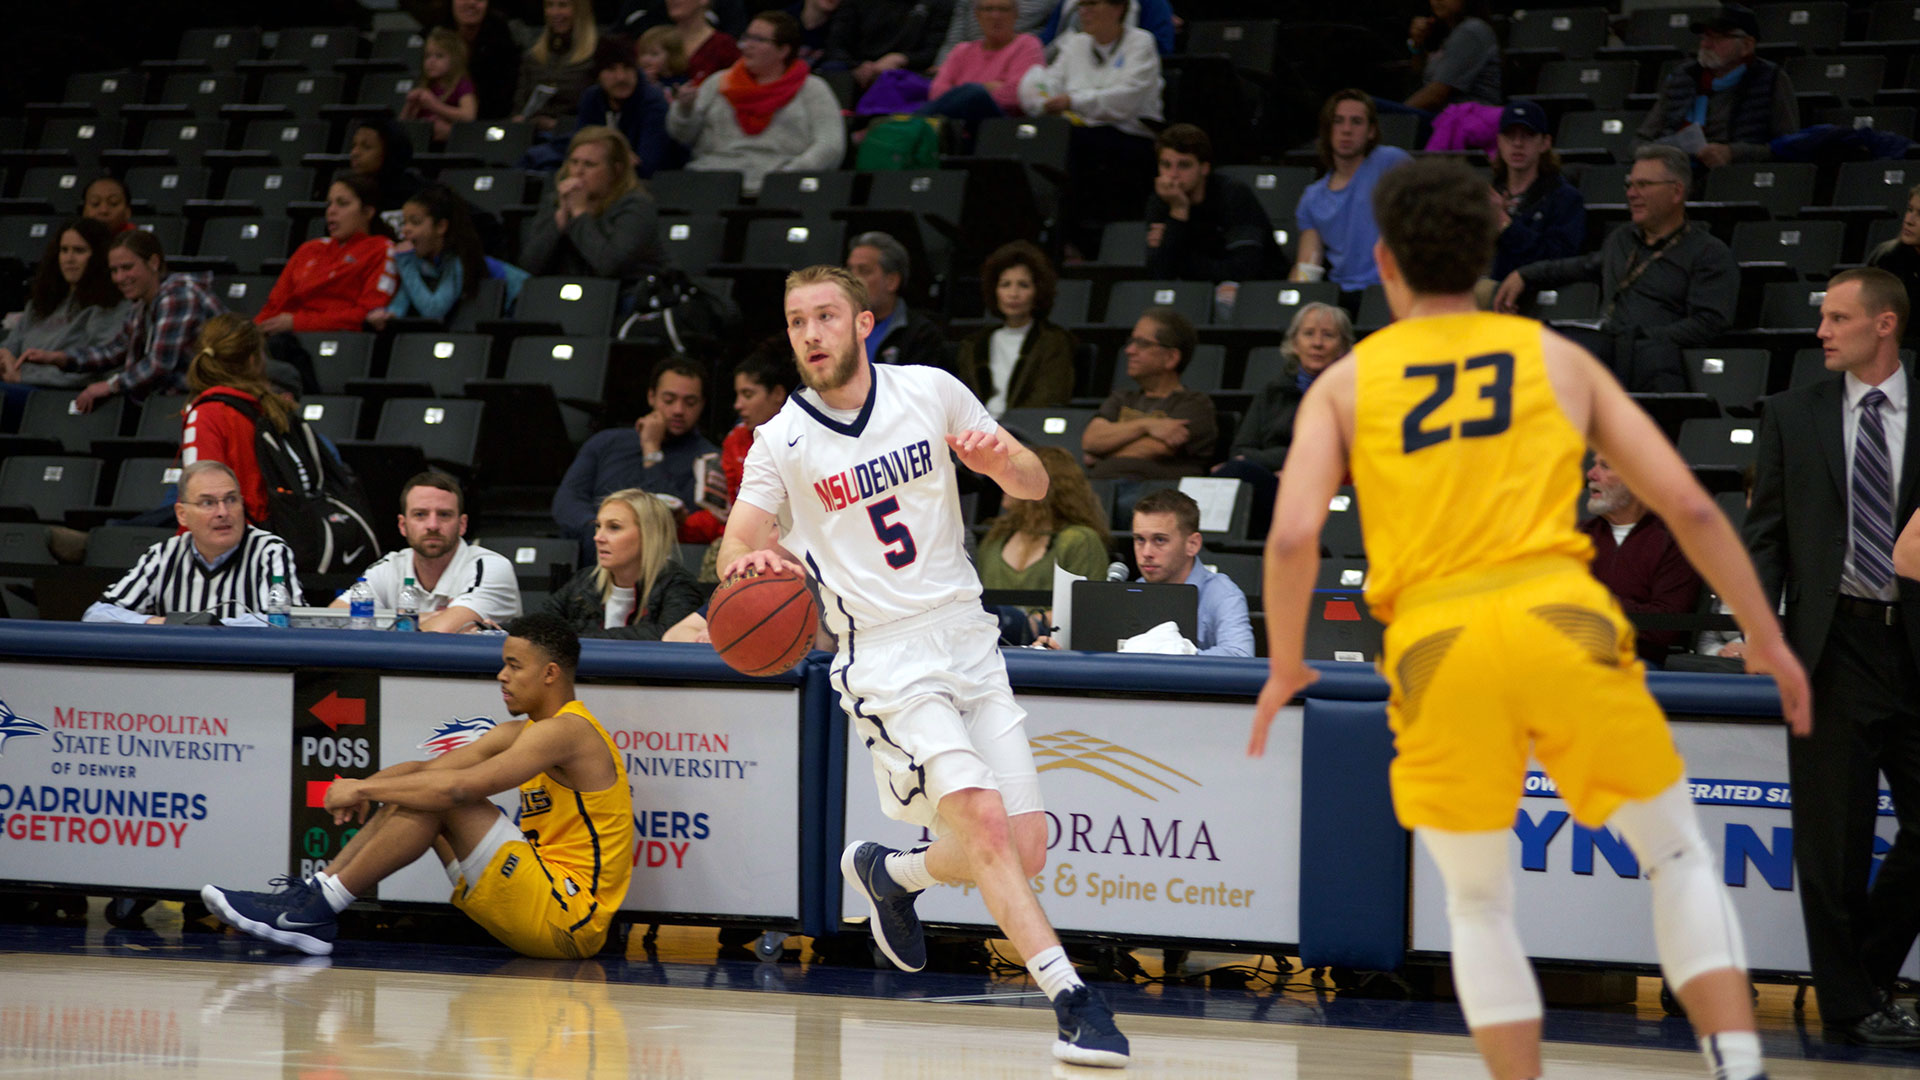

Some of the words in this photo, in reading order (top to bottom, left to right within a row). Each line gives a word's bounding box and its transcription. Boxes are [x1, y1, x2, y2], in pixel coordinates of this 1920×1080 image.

[1403, 350, 1516, 455] 23
[865, 494, 918, 570] 5
[53, 706, 229, 736] METROPOLITAN
[51, 731, 110, 755] STATE
[301, 736, 371, 769] POSS
[608, 729, 729, 753] OPOLITAN
[51, 762, 72, 775] OF
[78, 763, 137, 779] DENVER
[1053, 862, 1078, 897] &
[1086, 872, 1158, 906] Spine
[1165, 877, 1256, 908] Center
